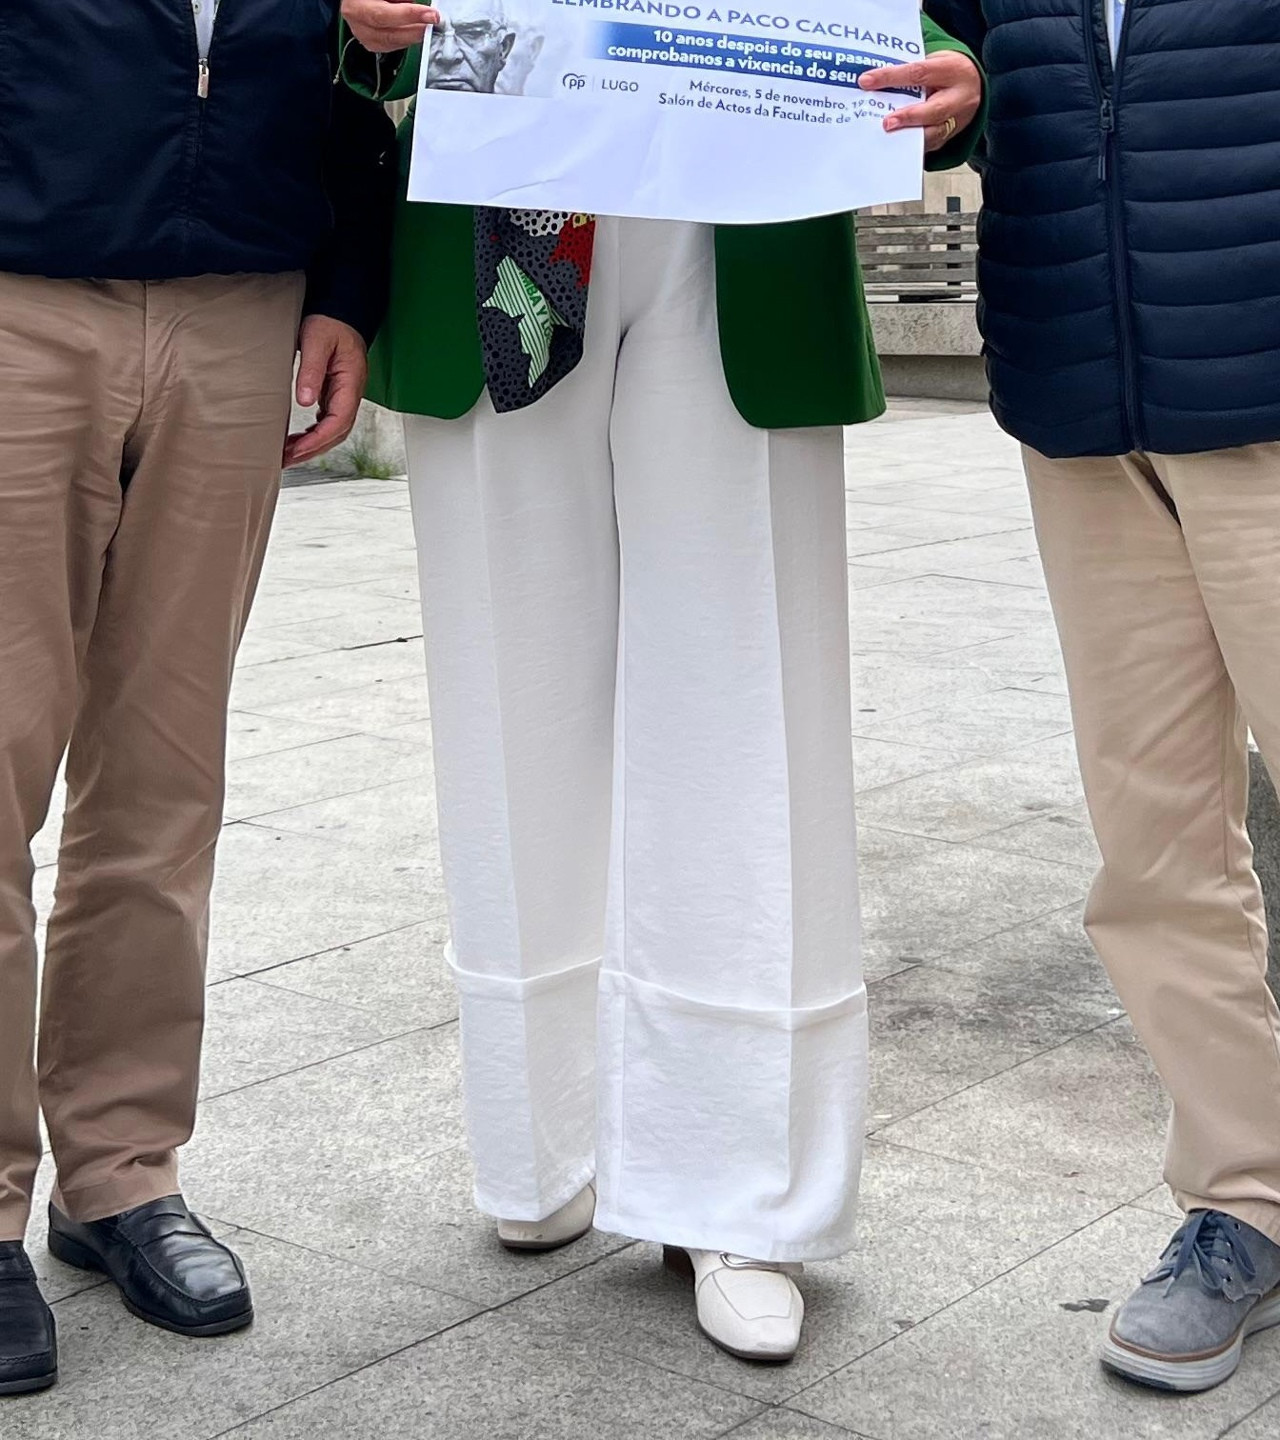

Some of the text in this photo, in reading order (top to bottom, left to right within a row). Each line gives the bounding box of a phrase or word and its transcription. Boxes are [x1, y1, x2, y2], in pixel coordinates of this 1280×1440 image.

[653, 29, 673, 43] 10
[675, 33, 714, 48] anos
[716, 35, 778, 55] despois
[781, 42, 802, 58] do
[804, 48, 832, 61] seu
[706, 8, 722, 22] A
[727, 10, 790, 29] PACO
[795, 19, 920, 55] CACHARRO
[607, 45, 858, 84] comprobamos a vixencia do seu
[601, 78, 639, 92] LUGO
[689, 79, 752, 100] Mércores,
[755, 89, 762, 99] 5
[765, 89, 781, 101] de
[658, 92, 694, 108] Salón
[697, 95, 713, 109] de
[715, 99, 752, 115] Actos
[754, 103, 770, 117] da
[772, 106, 833, 124] Facultade
[836, 111, 853, 124] de
